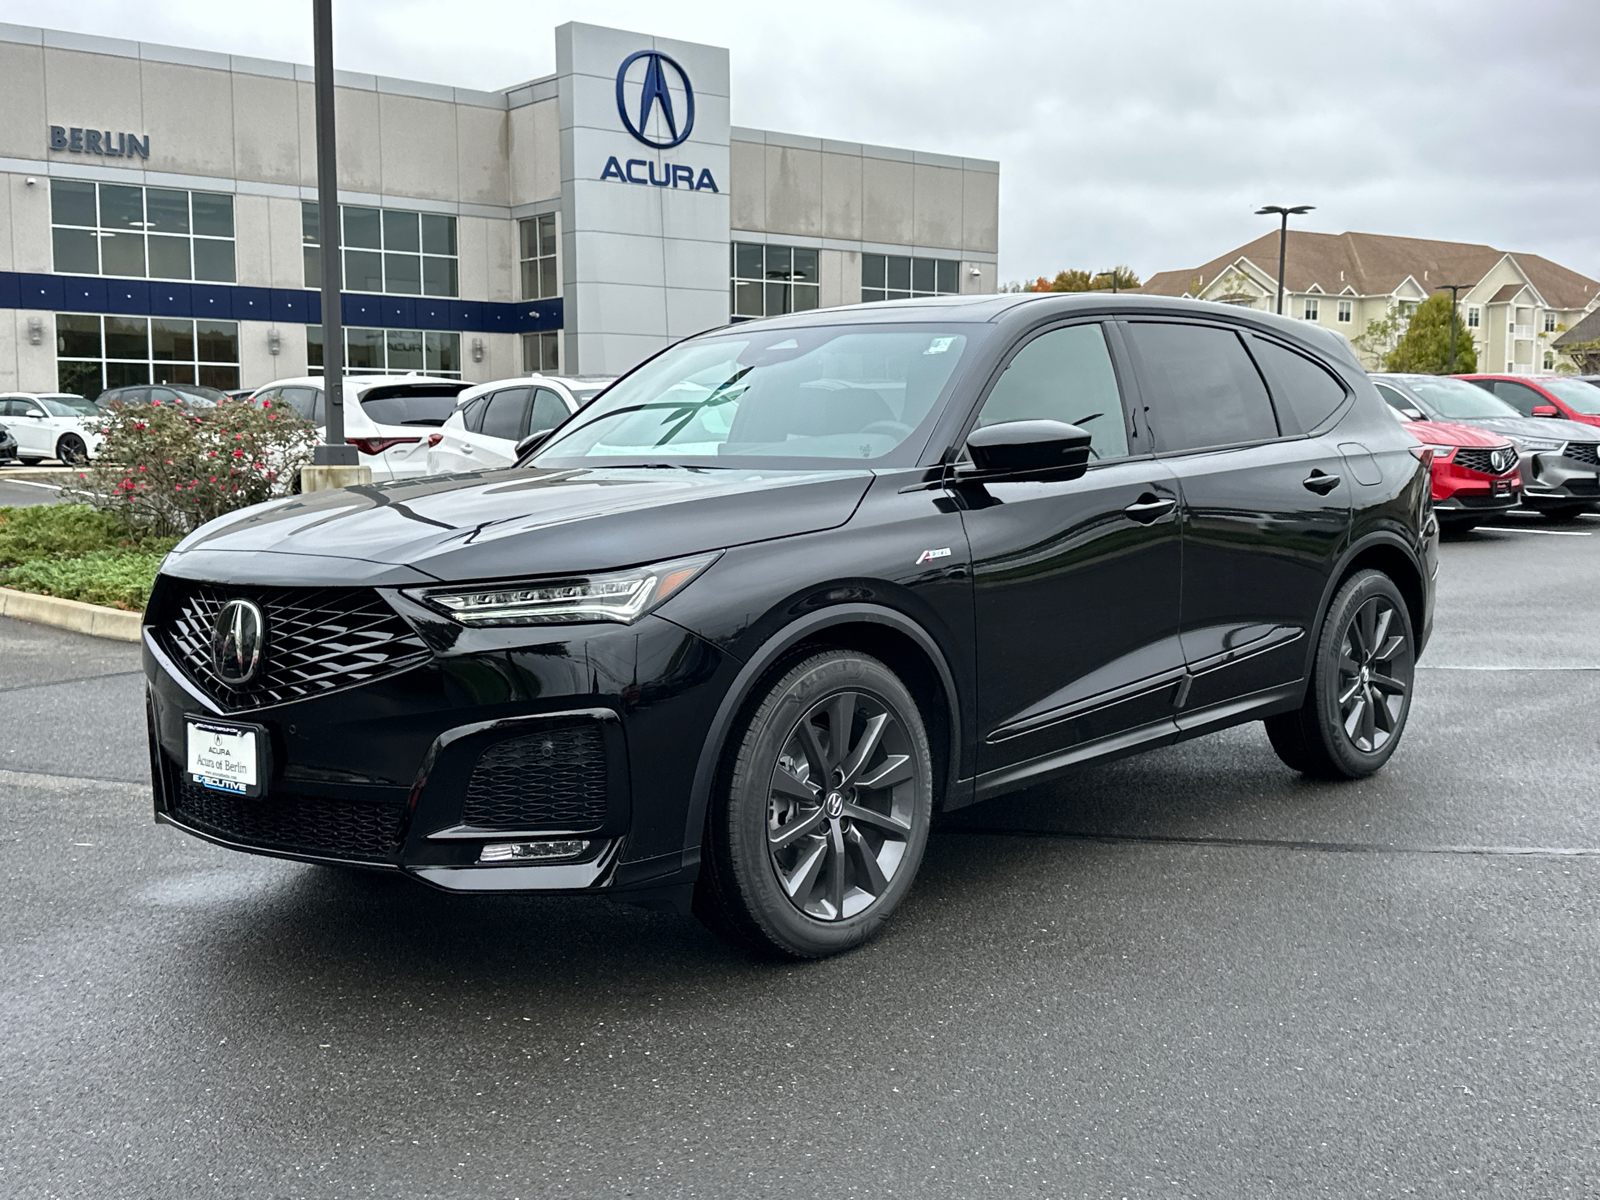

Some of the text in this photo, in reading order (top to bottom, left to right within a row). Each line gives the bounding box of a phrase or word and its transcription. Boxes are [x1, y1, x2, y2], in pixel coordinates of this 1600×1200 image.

[50, 125, 150, 159] BERLIN
[600, 155, 719, 193] ACURA
[208, 746, 231, 756] ACURA
[196, 754, 247, 774] Acura of Berlin
[193, 774, 246, 791] EXECUTIVE
